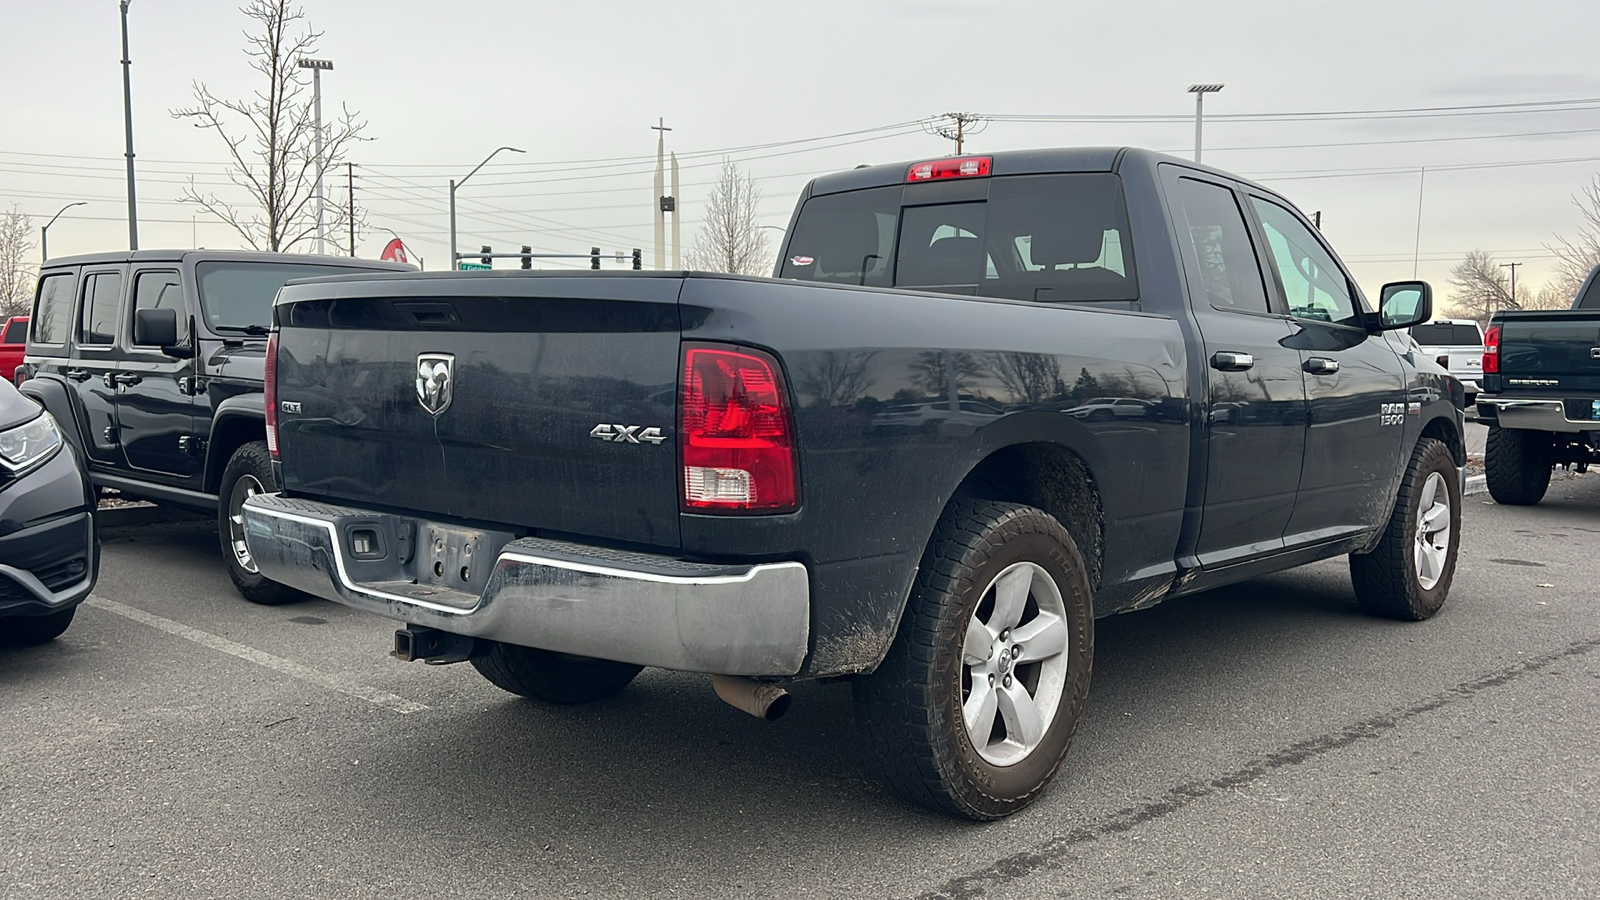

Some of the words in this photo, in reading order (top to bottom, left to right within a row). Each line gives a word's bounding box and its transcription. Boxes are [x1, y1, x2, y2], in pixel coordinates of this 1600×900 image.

[282, 401, 300, 413] SLT
[1381, 402, 1405, 415] RAM
[1381, 414, 1405, 426] 1500
